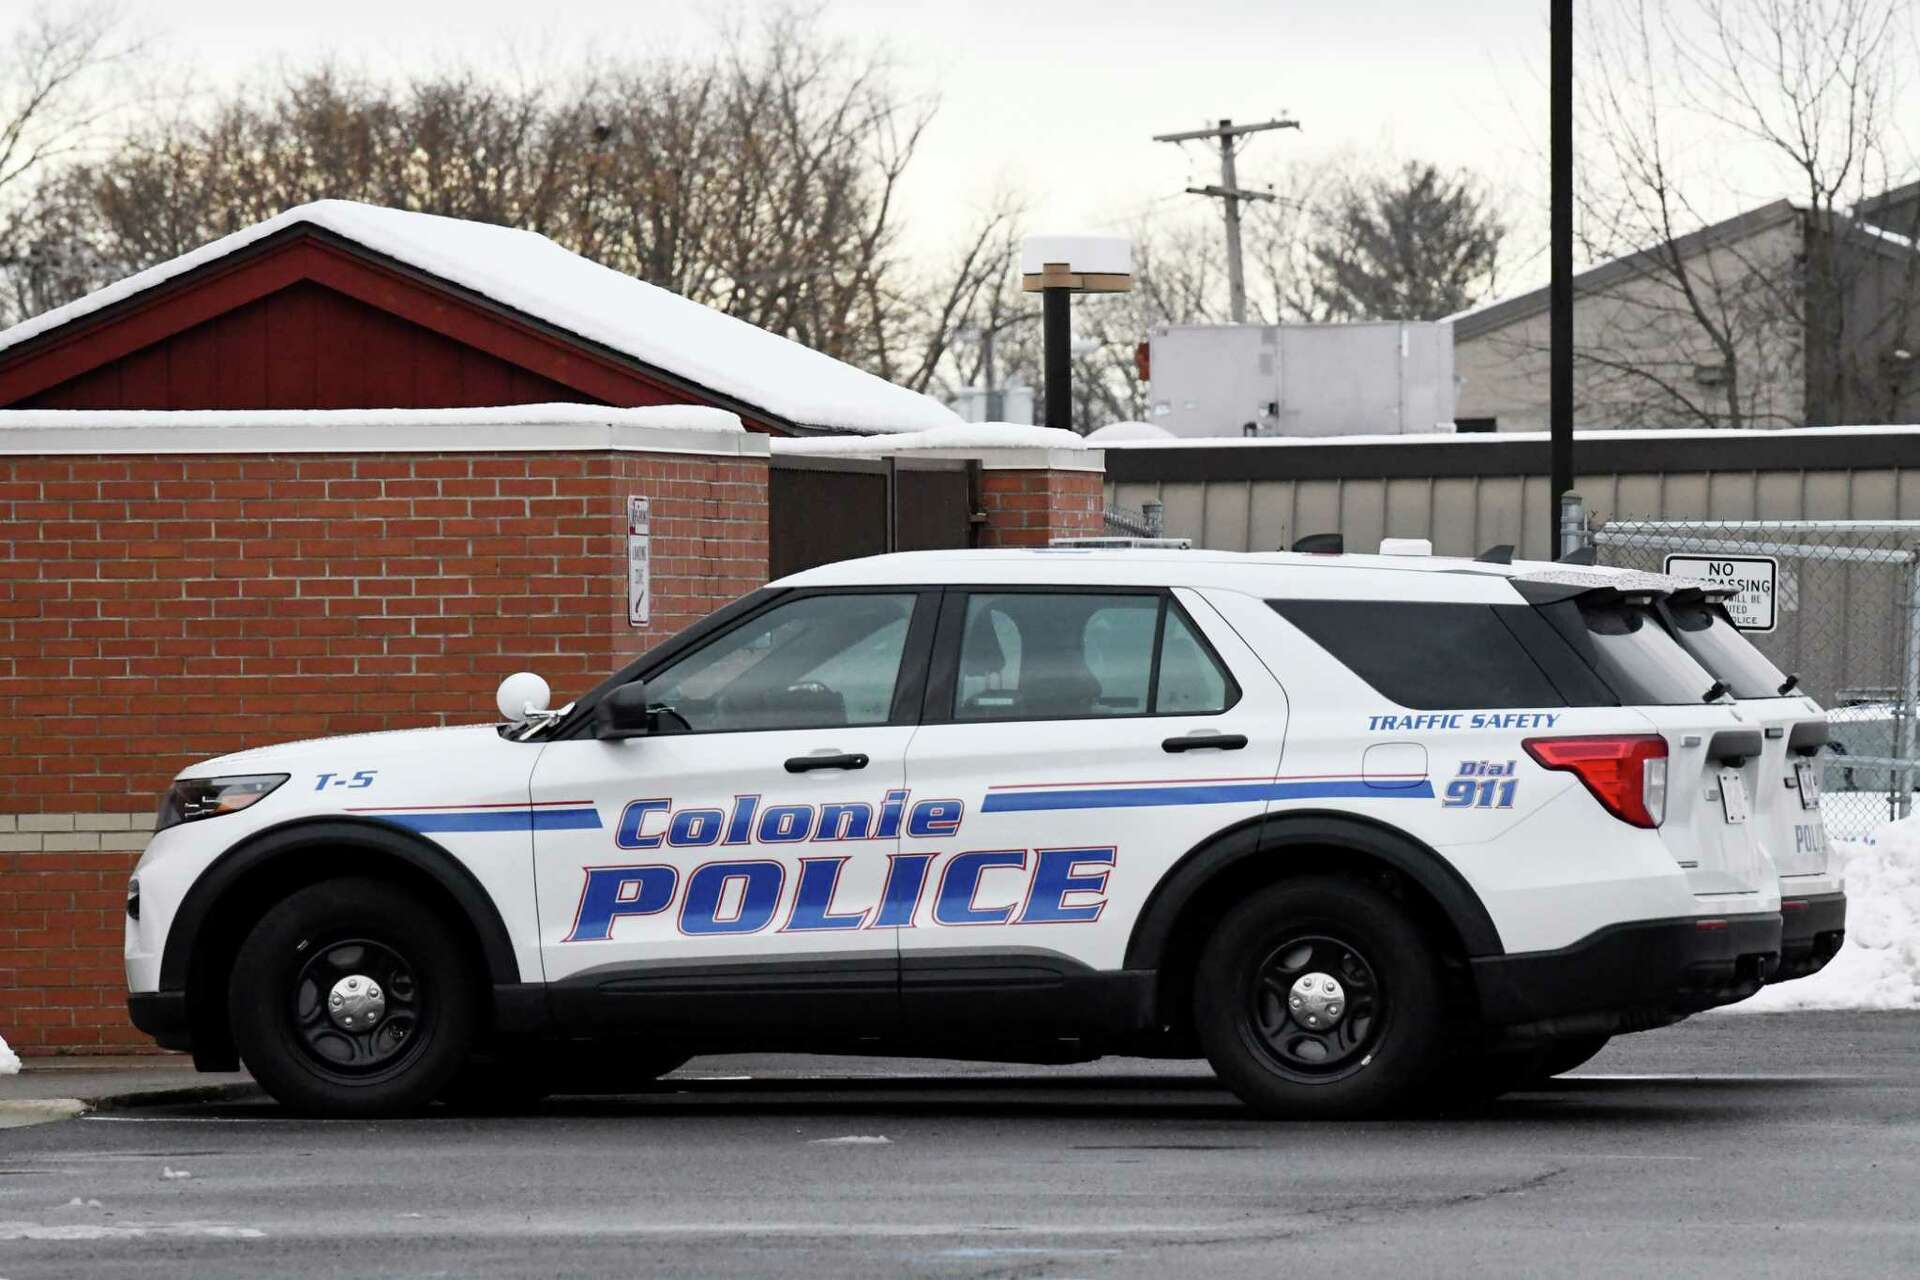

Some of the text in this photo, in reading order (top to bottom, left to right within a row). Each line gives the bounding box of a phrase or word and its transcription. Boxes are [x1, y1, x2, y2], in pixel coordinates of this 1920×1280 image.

[1709, 562, 1734, 576] NO
[1368, 712, 1560, 731] TRAFFIC SAFETY
[1456, 760, 1517, 777] Dial
[314, 770, 379, 791] T-5
[1441, 778, 1520, 809] 911
[615, 789, 964, 849] Colonie
[562, 846, 1118, 943] POLICE
